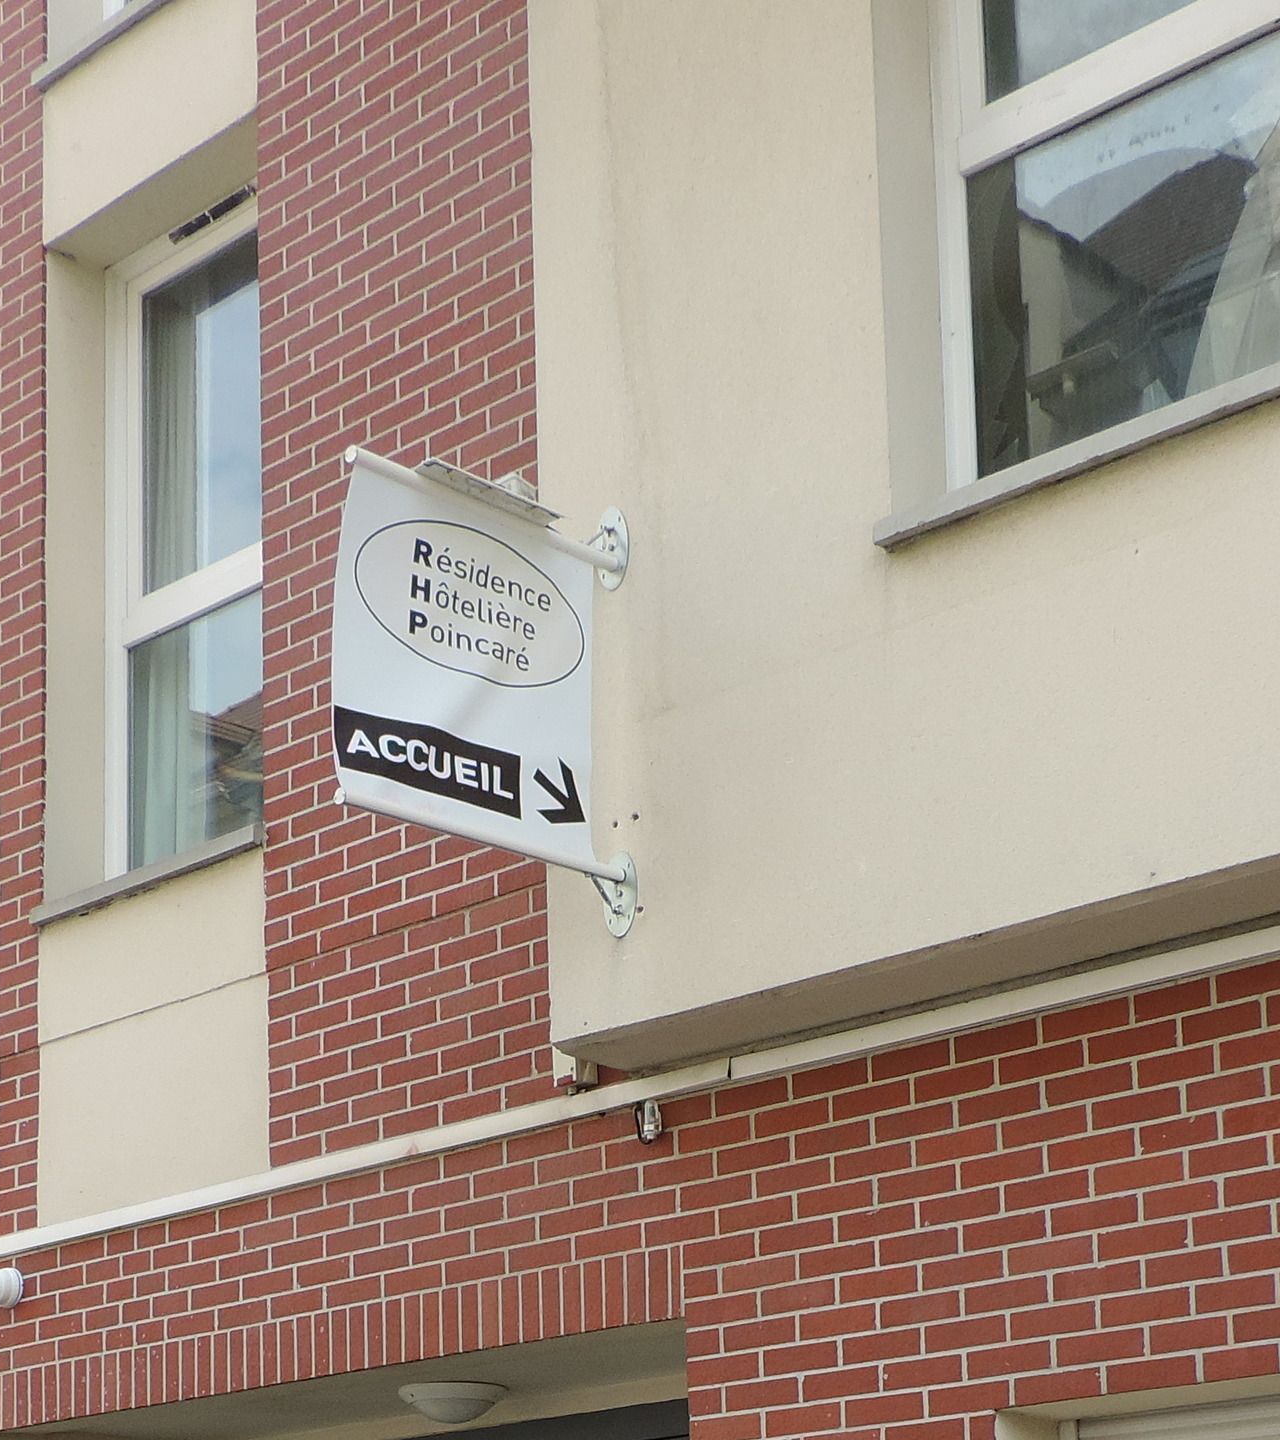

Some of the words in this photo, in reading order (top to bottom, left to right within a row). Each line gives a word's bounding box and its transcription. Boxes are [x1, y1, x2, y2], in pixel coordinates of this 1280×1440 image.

[410, 573, 536, 641] Hôtelière
[413, 537, 552, 612] Résidence
[408, 608, 531, 672] Poincaré
[346, 728, 515, 801] ACCUEIL
